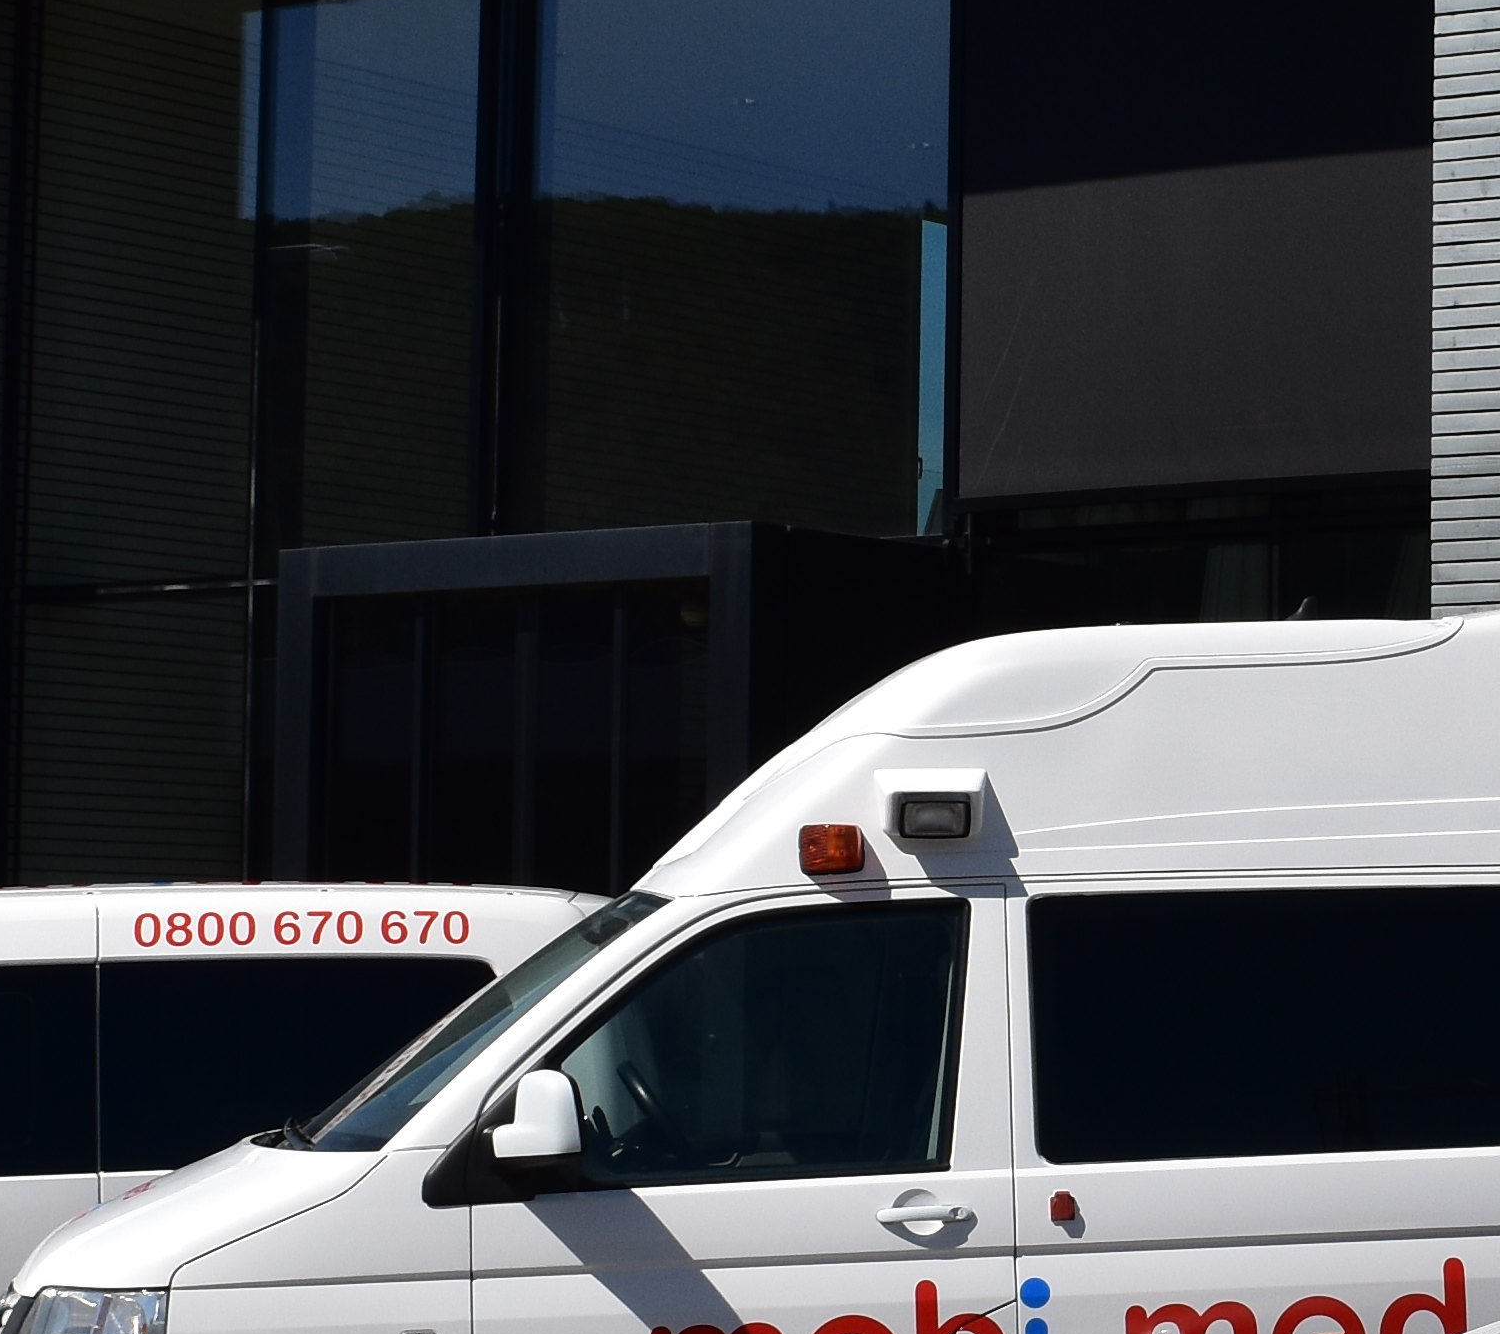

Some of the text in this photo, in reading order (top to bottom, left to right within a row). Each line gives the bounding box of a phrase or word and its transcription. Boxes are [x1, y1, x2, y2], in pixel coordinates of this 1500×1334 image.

[133, 910, 470, 948] 0800 670 670
